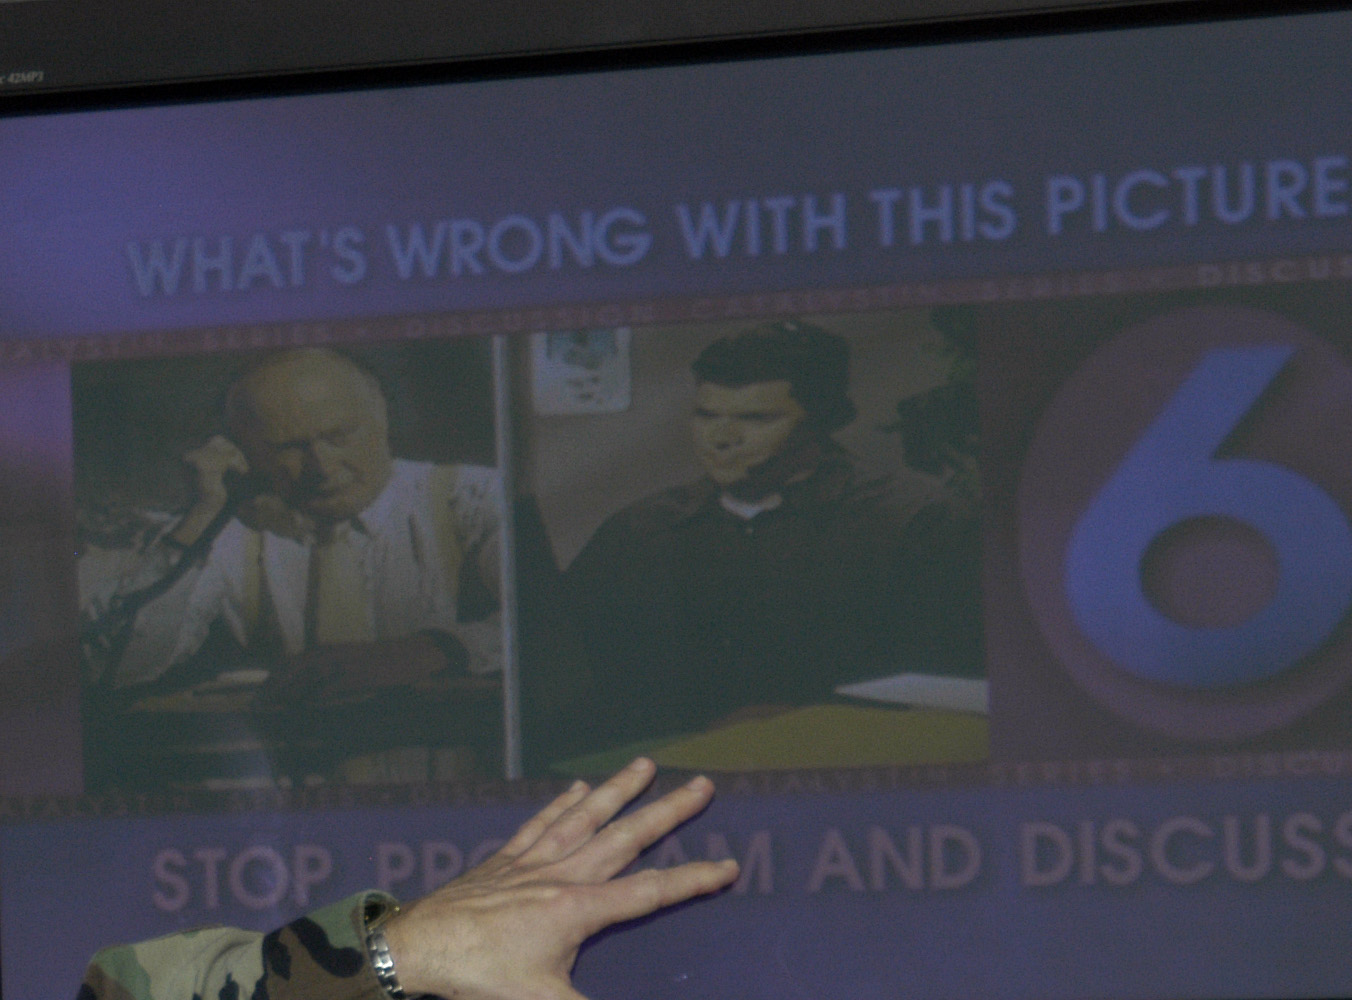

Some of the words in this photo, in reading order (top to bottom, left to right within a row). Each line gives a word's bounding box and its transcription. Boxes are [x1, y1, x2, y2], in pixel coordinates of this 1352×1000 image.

[126, 229, 367, 297] WHAT'S
[386, 208, 653, 280] WRONG
[675, 194, 847, 260] WITH
[870, 181, 1017, 247] THIS
[1048, 156, 1347, 234] PICTURE
[1064, 345, 1352, 688] 6
[152, 842, 333, 912] STOP
[809, 825, 982, 893] AND
